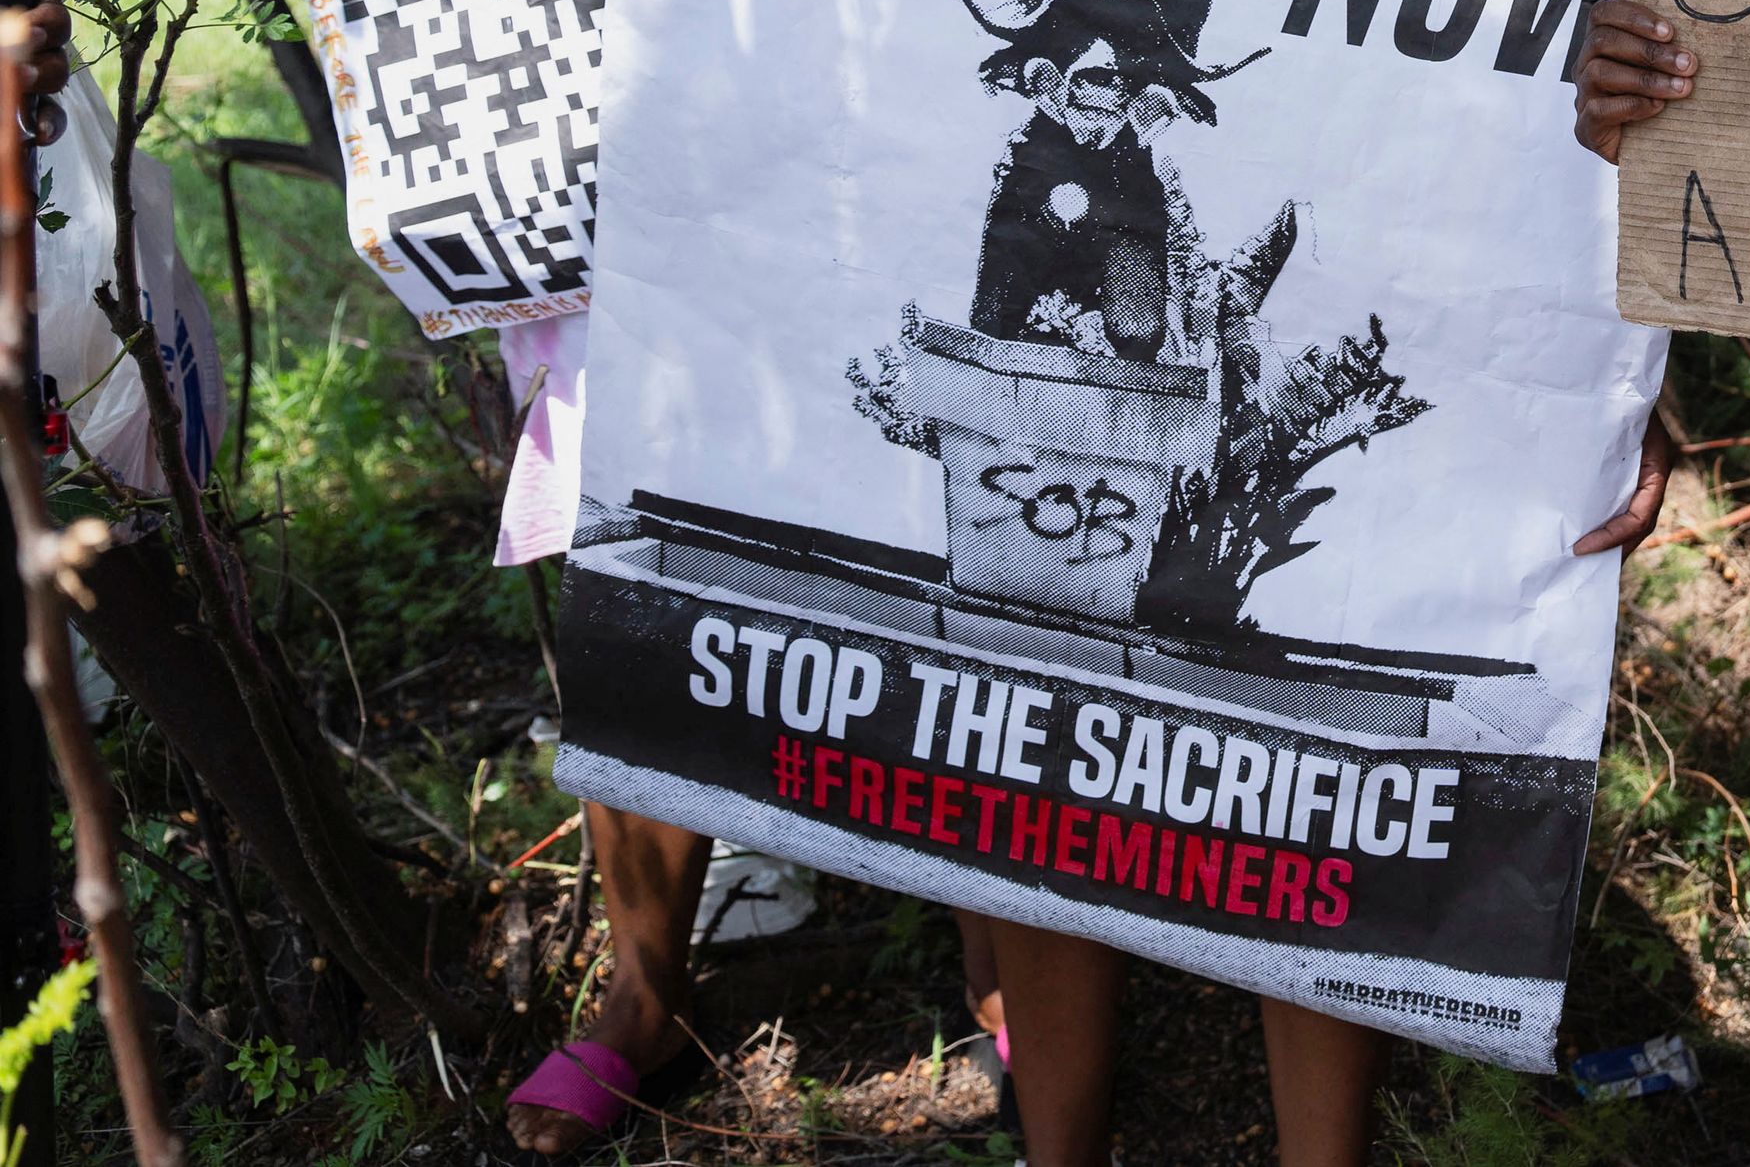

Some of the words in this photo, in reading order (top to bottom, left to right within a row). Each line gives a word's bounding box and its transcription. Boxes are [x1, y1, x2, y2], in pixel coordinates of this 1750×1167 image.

[689, 617, 883, 740] STOP
[909, 661, 1055, 785] THE
[1068, 703, 1462, 860] SACRIFICE
[771, 734, 1354, 928] #FREETHEMINERS
